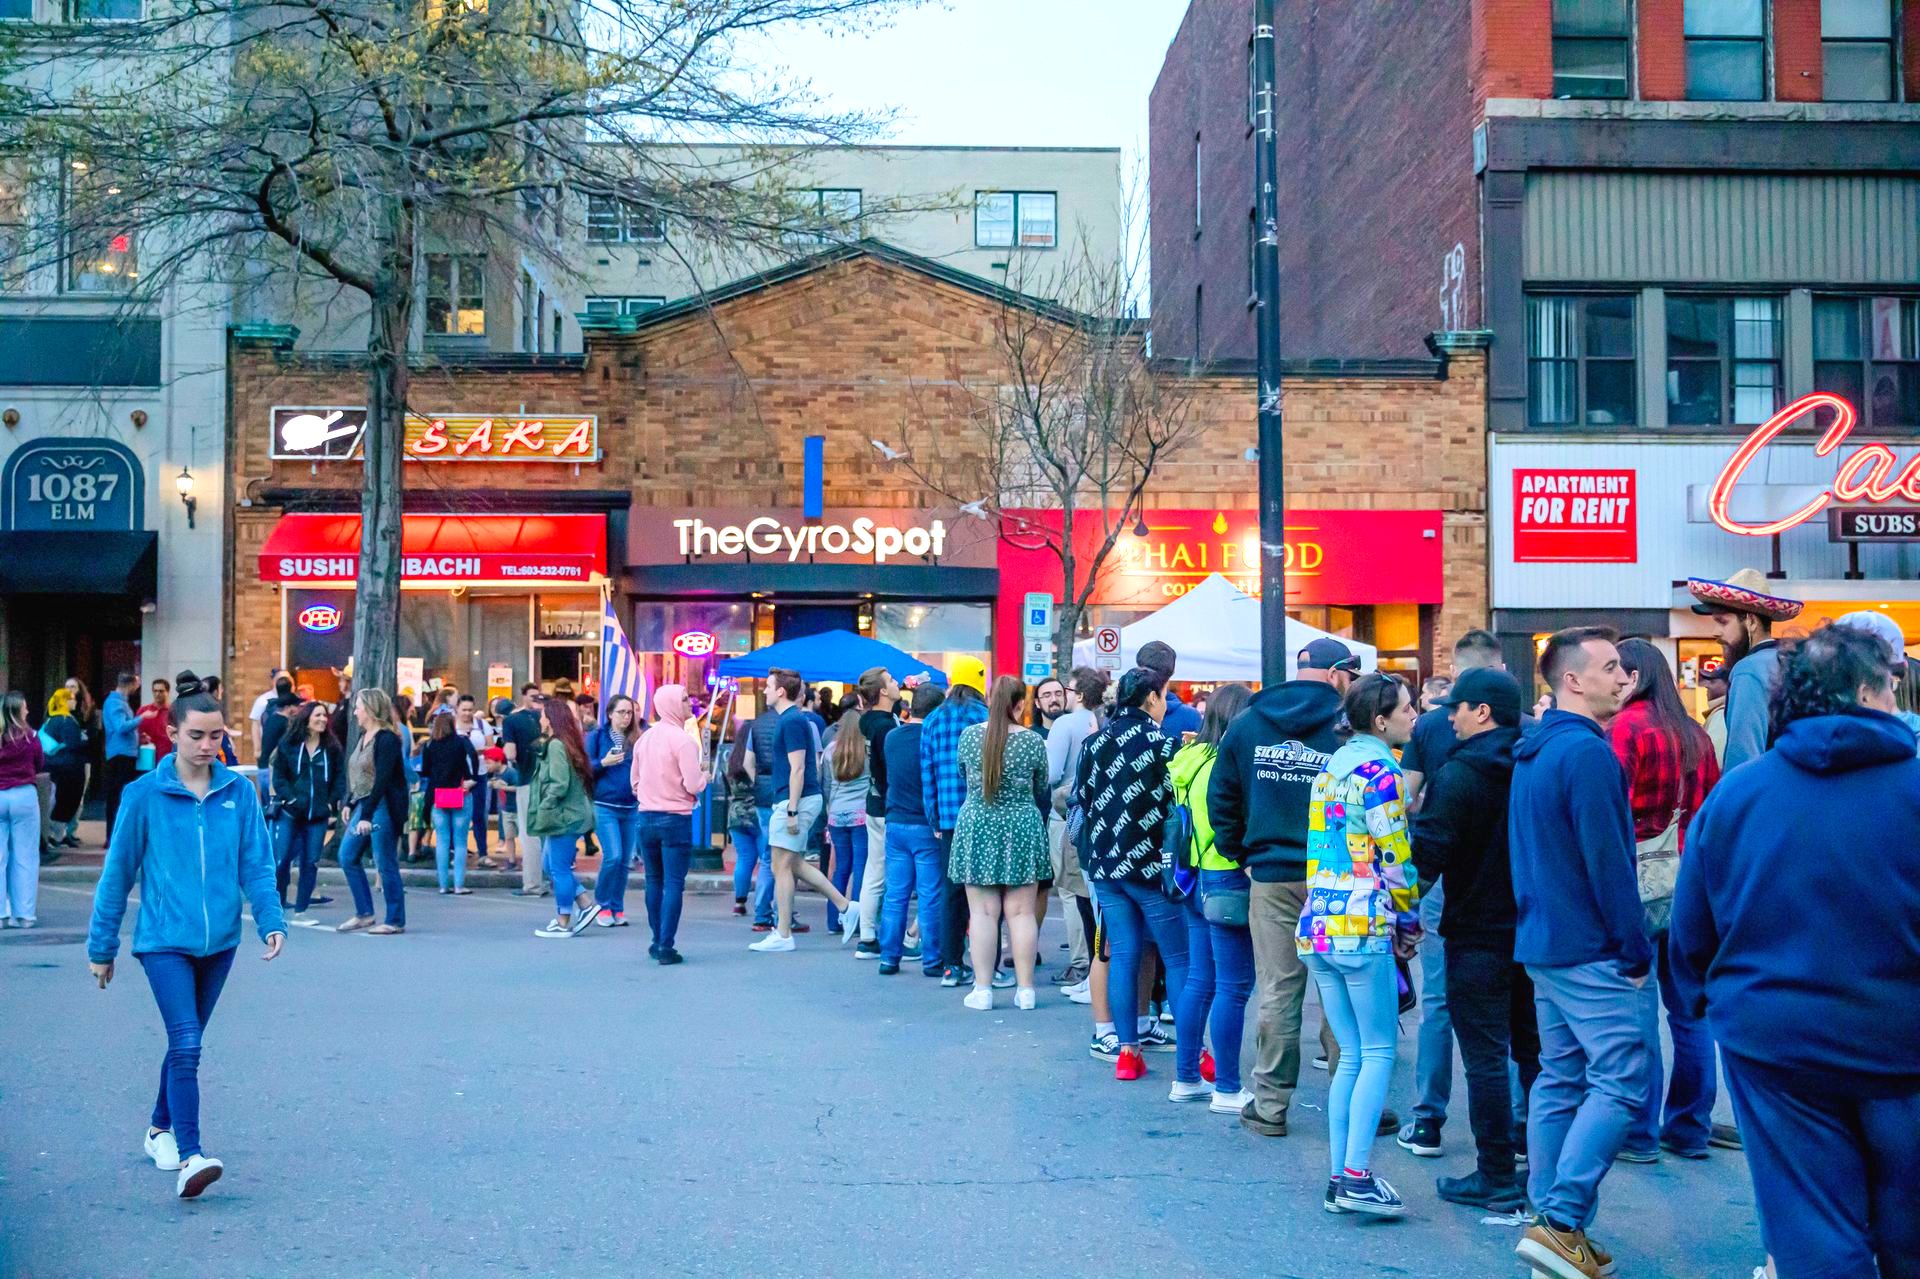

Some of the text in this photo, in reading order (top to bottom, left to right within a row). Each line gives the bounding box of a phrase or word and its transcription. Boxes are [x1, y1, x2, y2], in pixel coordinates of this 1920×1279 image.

[28, 473, 118, 502] 1087
[1521, 475, 1629, 494] APARTMENT
[51, 503, 95, 520] ELM
[1520, 497, 1630, 524] FOR RENT
[1854, 514, 1916, 534] SUBS
[673, 517, 947, 562] TheGyroSpot
[279, 557, 354, 577] SUSHI
[400, 557, 481, 576] IBACHI
[299, 610, 342, 627] OPEN
[545, 623, 584, 635] 1077
[673, 633, 716, 653] OPEN
[1115, 724, 1142, 748] DKNY
[1130, 749, 1156, 773] DKNY
[1254, 746, 1296, 761] SILVA'S
[1105, 752, 1126, 780] DKNY
[1256, 769, 1280, 783] (603)
[1094, 783, 1116, 812] DKNY
[1121, 778, 1146, 804] DKNY
[1090, 816, 1107, 845] DKNY
[1112, 809, 1132, 838] DKNY
[1138, 806, 1164, 832] DKNY
[1126, 836, 1154, 860] DKNY
